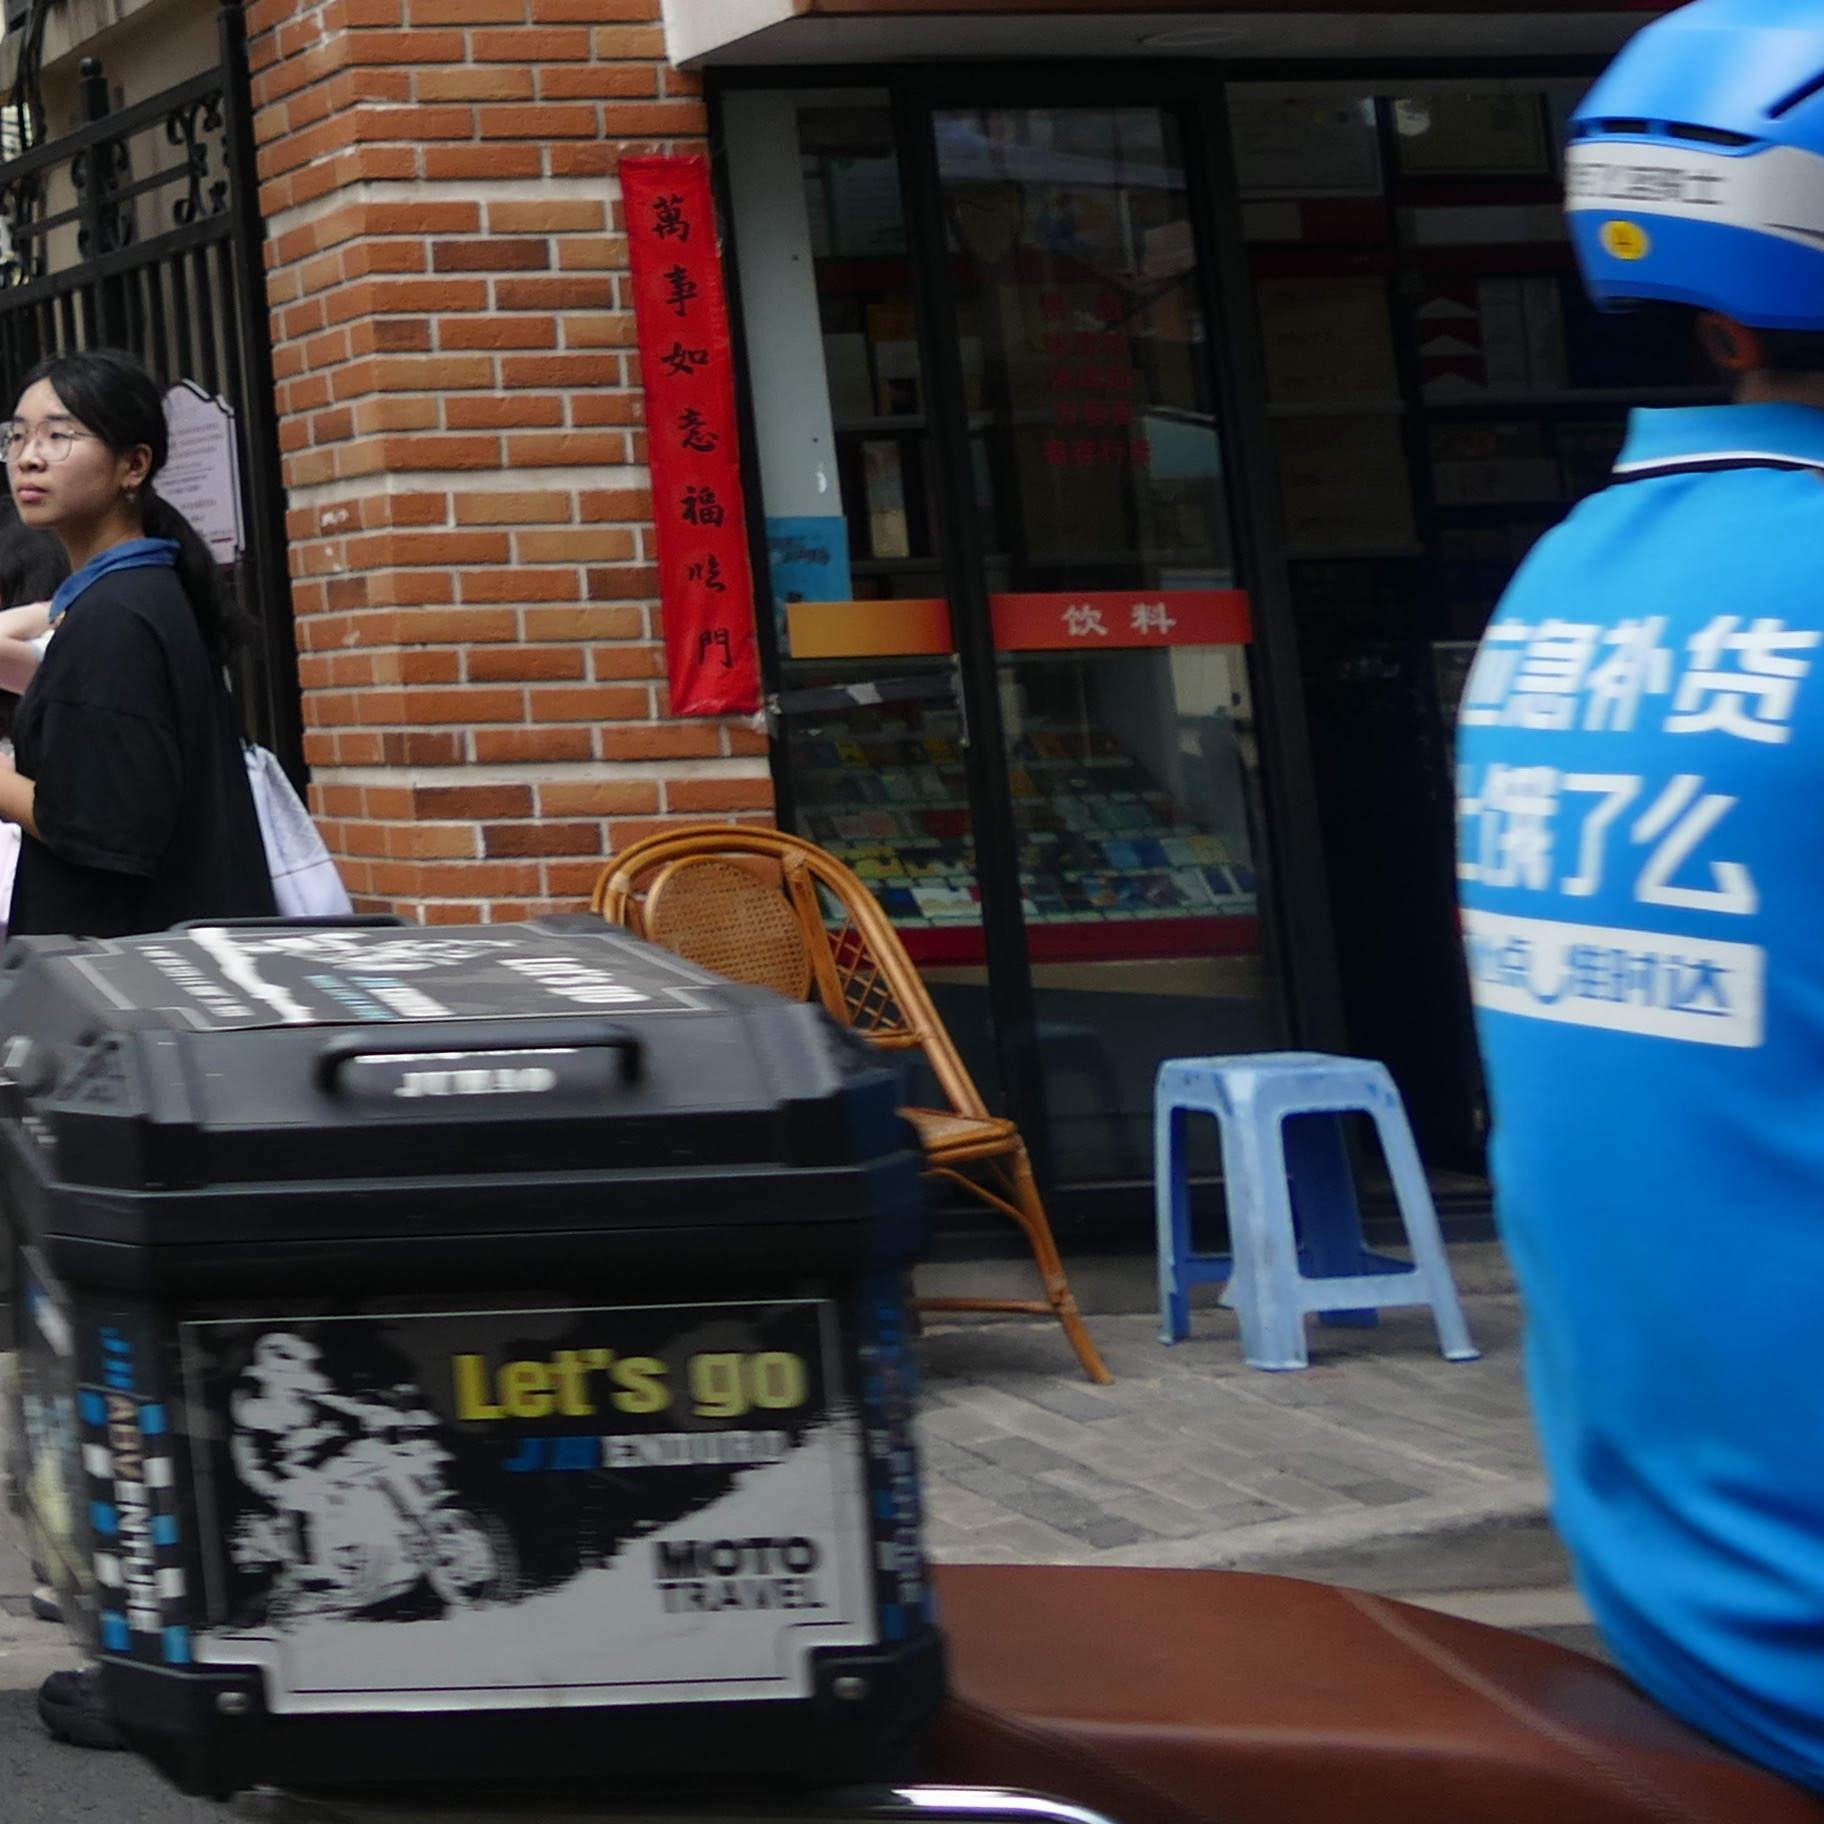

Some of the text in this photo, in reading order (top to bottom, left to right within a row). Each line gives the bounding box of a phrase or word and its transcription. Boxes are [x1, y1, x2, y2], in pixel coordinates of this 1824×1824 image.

[1061, 602, 1177, 637] 饮料
[451, 1347, 812, 1422] Let's go
[656, 1536, 820, 1578] MOTO
[659, 1580, 828, 1612] TRAVEL
